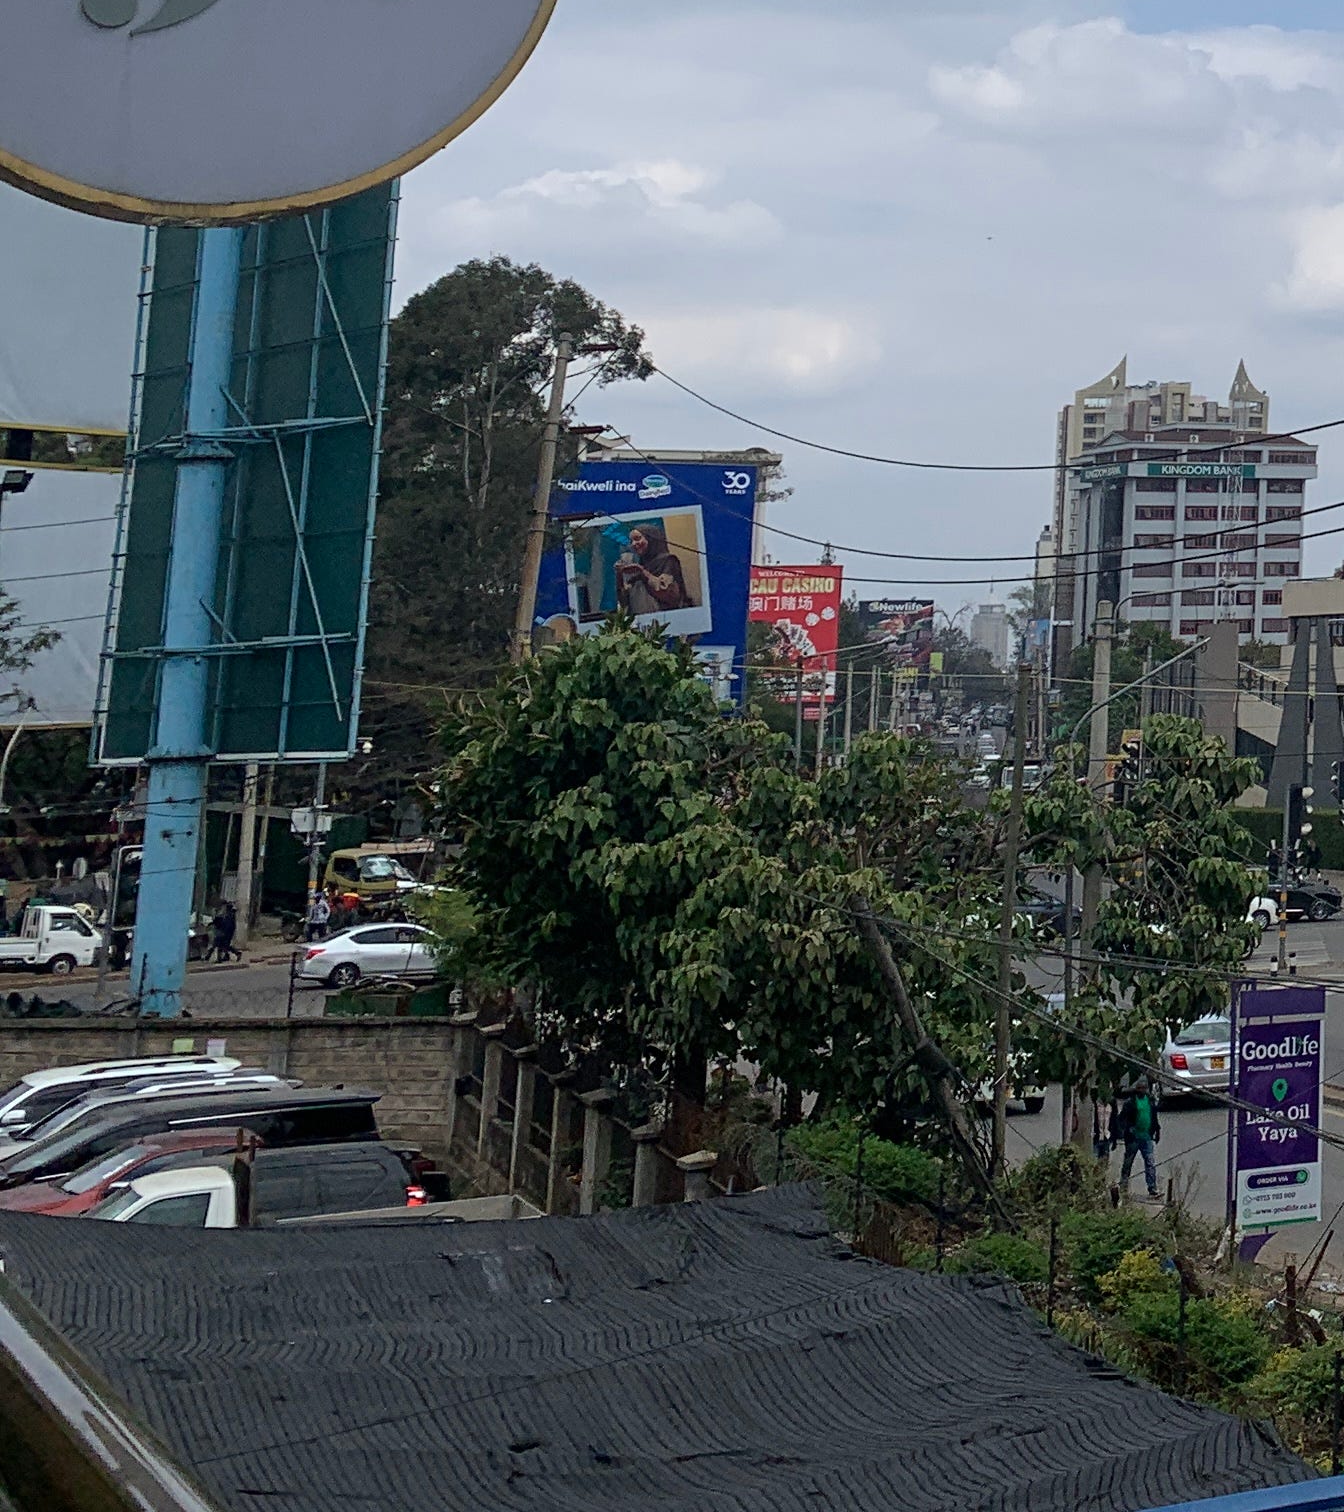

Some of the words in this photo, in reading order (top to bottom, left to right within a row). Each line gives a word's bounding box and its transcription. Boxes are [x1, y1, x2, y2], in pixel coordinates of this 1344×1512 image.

[1161, 465, 1210, 475] KINGDOM
[1213, 464, 1241, 475] BANK
[615, 480, 637, 492] ina
[722, 471, 750, 489] 30
[782, 577, 835, 594] CASINO
[1242, 1035, 1319, 1061] Goodlife
[1287, 1103, 1310, 1120] Oil
[1257, 1126, 1298, 1144] Yaya
[1256, 1176, 1277, 1185] ORDER
